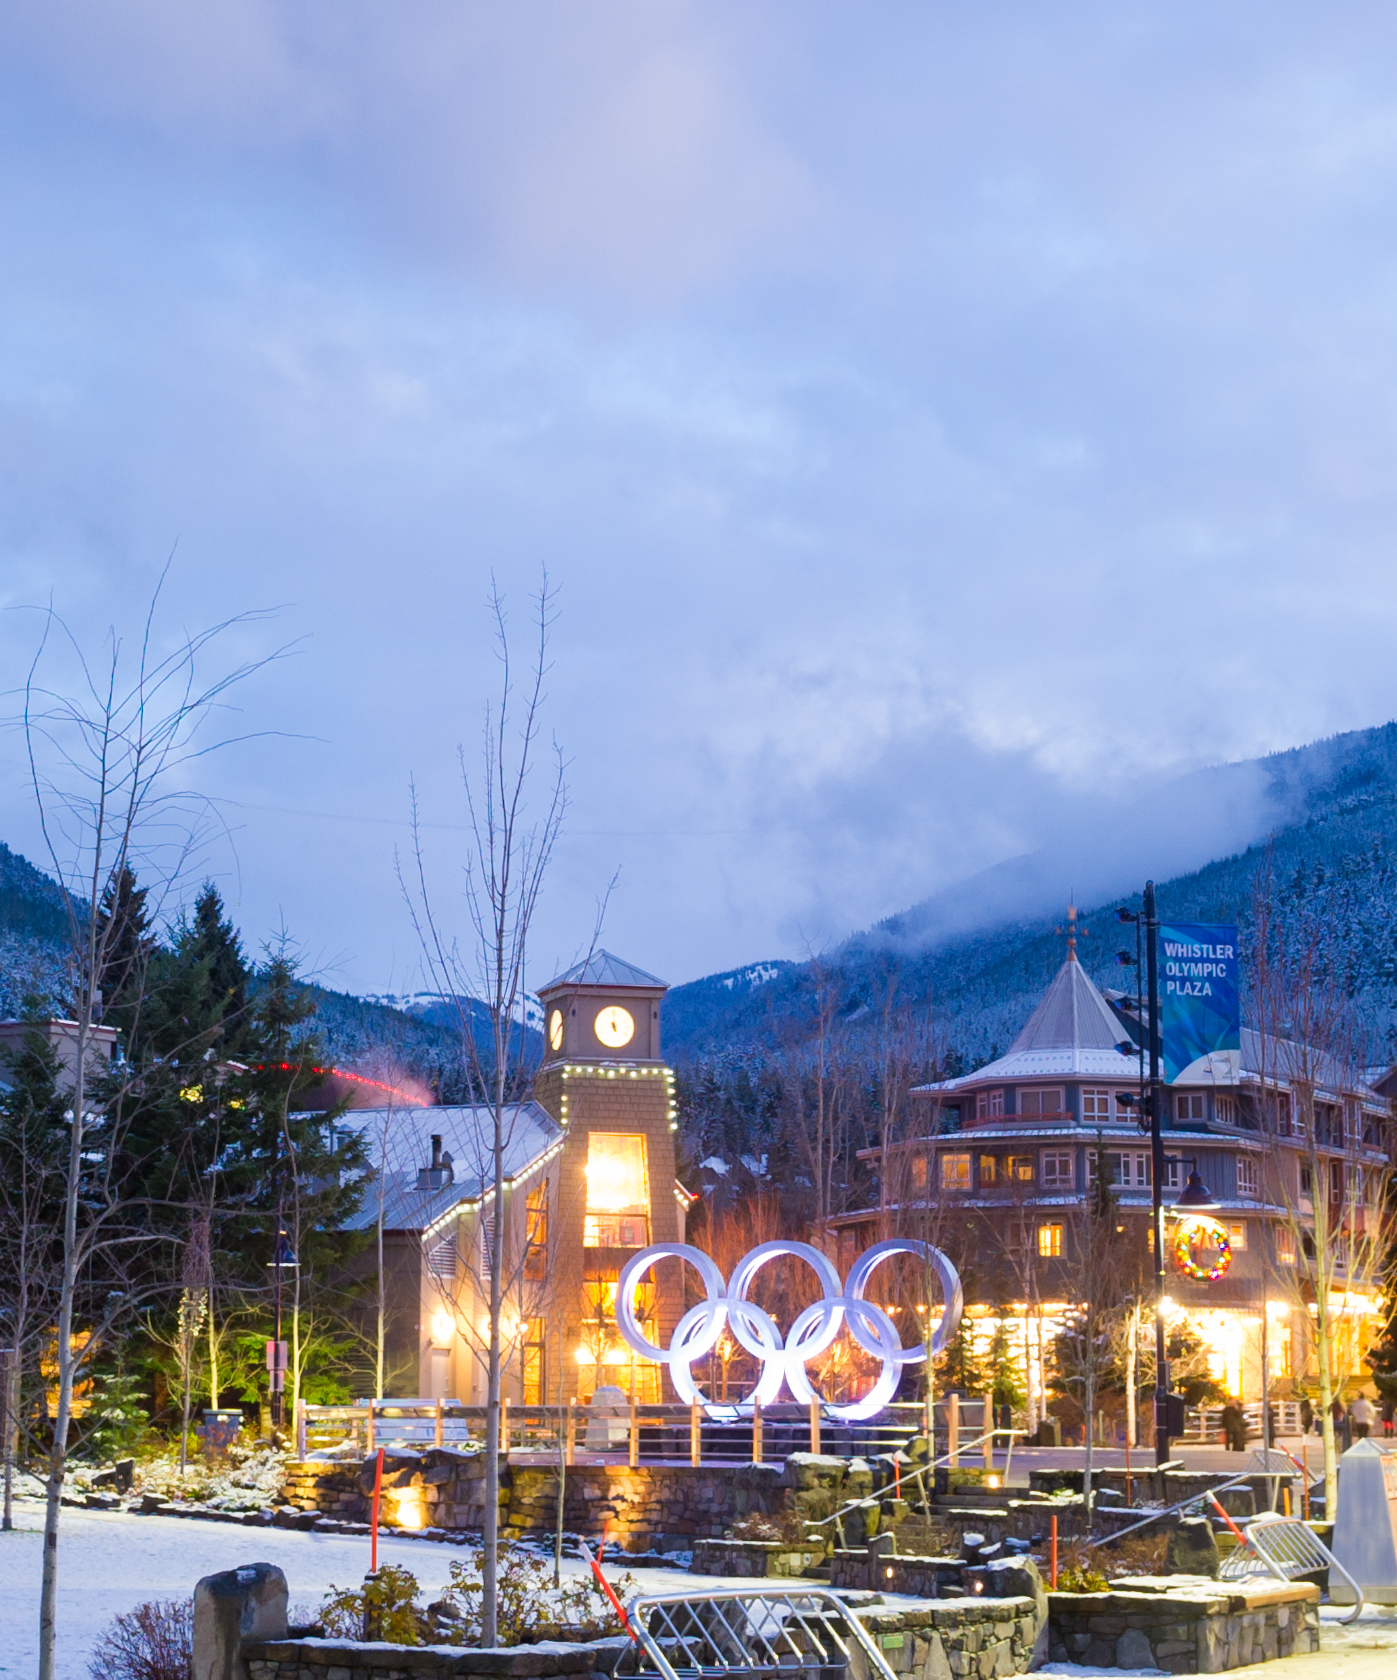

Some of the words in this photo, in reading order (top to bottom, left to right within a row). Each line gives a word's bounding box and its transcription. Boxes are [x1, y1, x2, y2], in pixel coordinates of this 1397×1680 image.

[1164, 942, 1234, 959] WHISTLER
[1165, 961, 1227, 977] OLYMPIC
[1166, 980, 1213, 996] PLAZA
